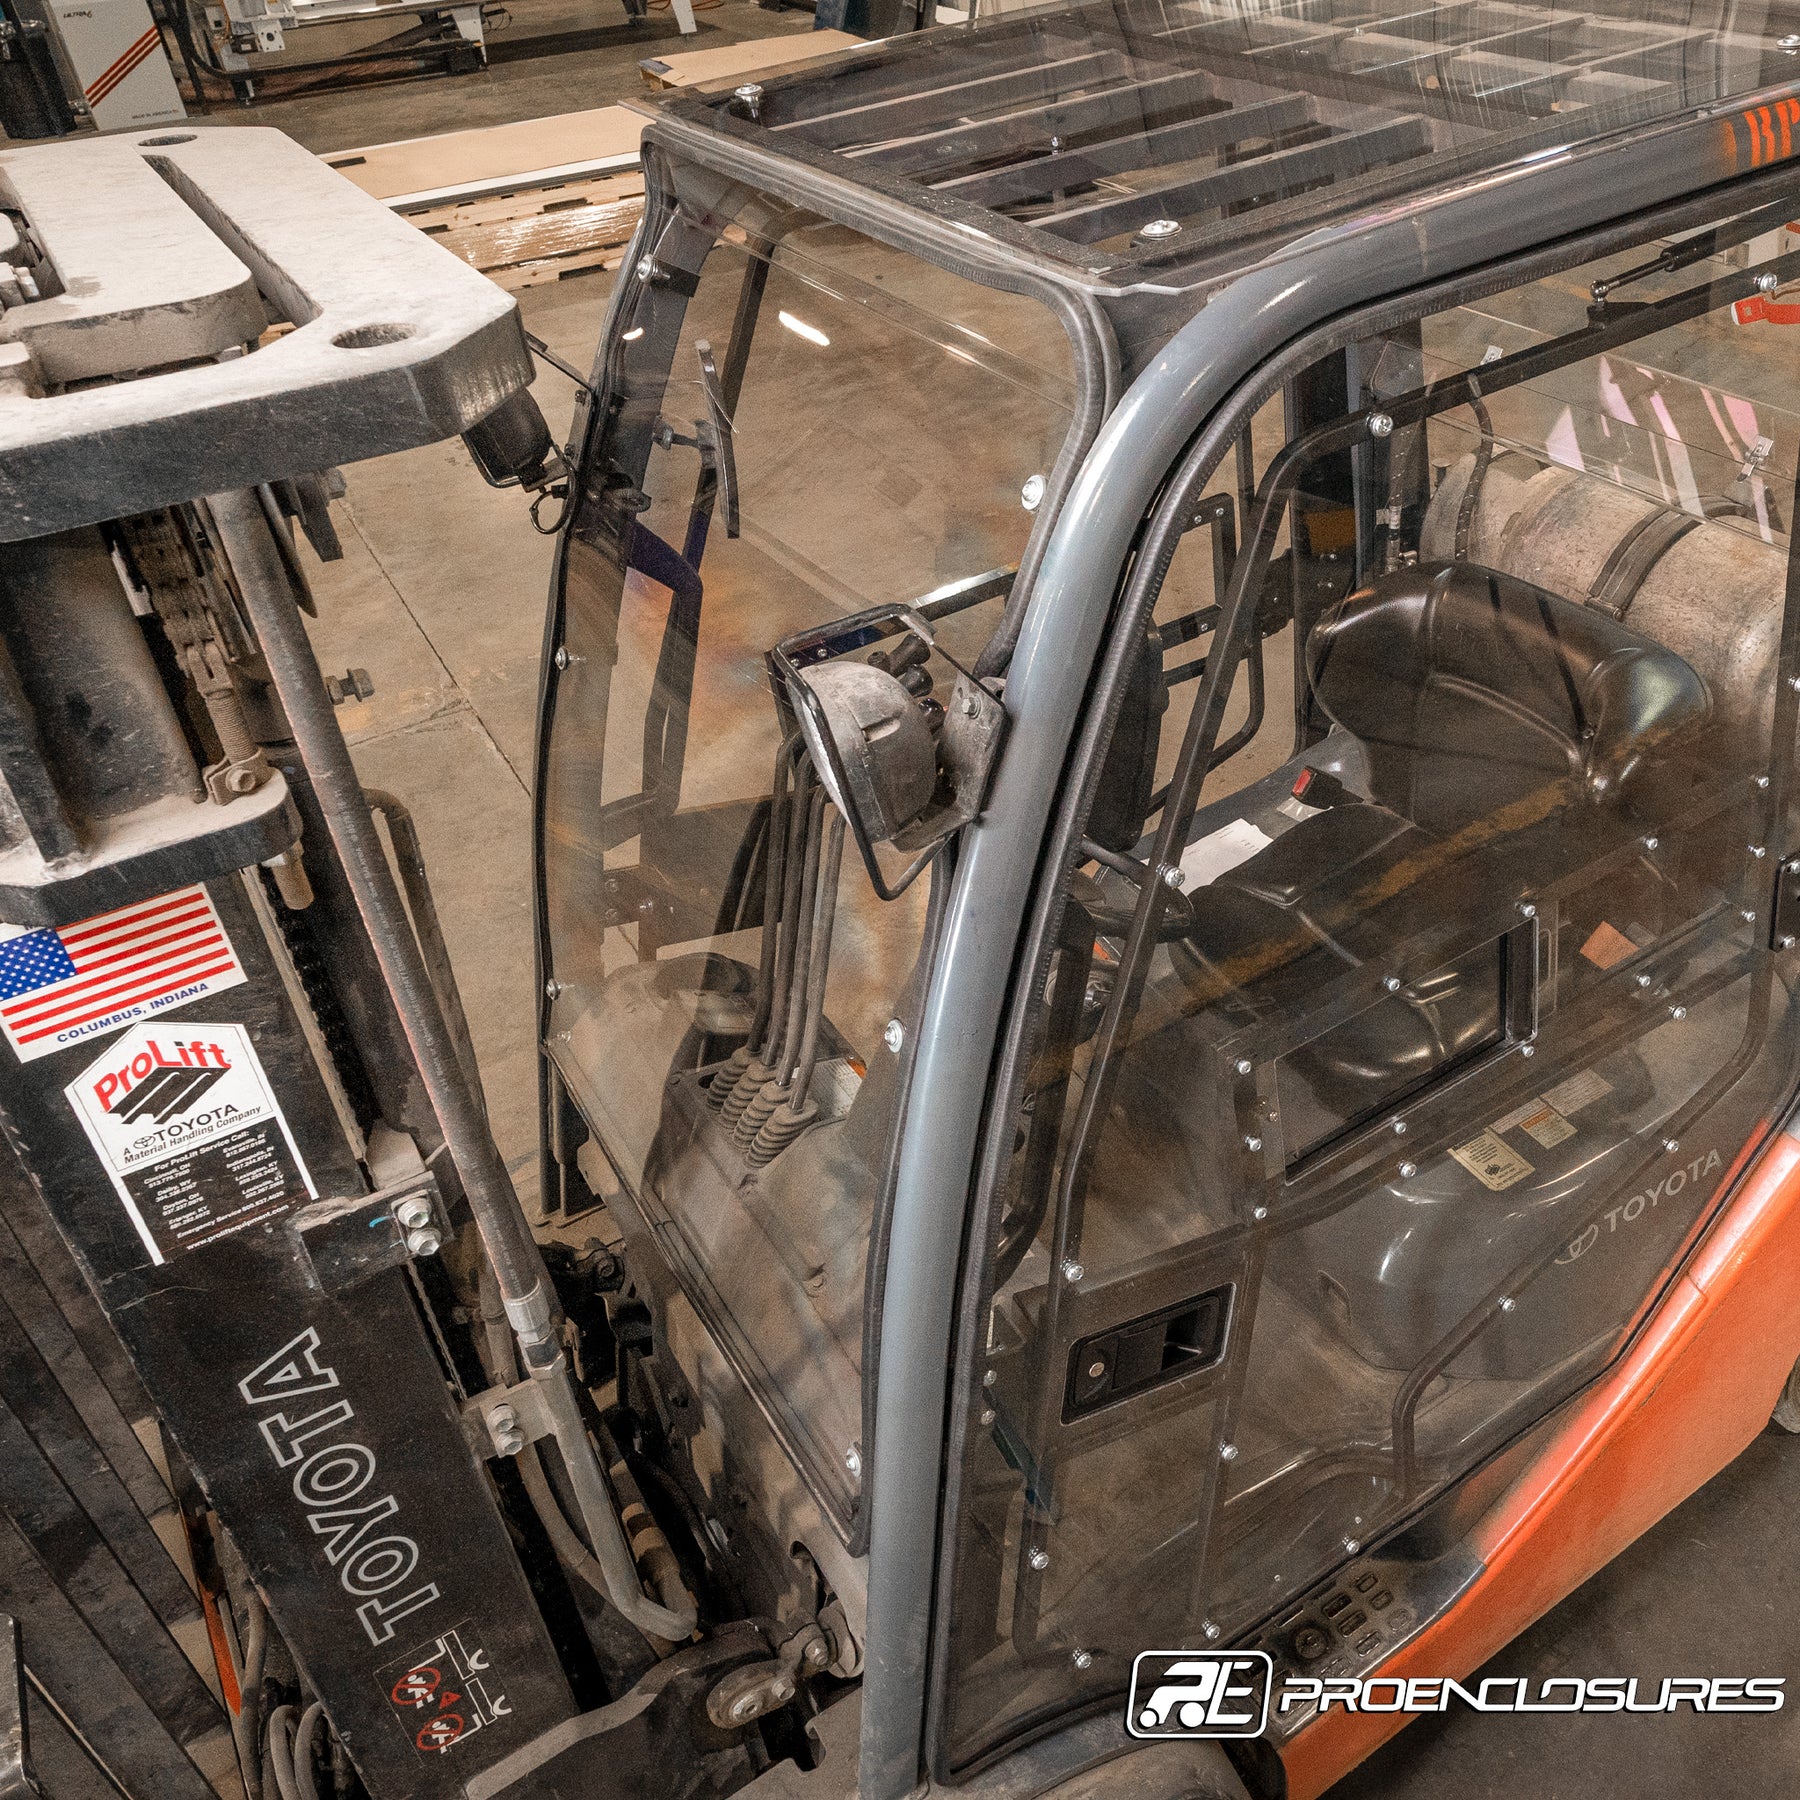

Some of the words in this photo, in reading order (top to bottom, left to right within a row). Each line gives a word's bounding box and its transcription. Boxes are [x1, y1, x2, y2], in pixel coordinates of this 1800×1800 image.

[56, 1006, 147, 1044] COLUMBUS,
[149, 982, 209, 1010] INDIANA
[93, 1040, 231, 1113] ProLift
[123, 1147, 130, 1156] A
[153, 1104, 238, 1142] TOYOTA
[124, 1142, 167, 1164] Material
[169, 1124, 214, 1146] Handling
[216, 1106, 262, 1128] Company
[153, 1161, 169, 1171] For
[169, 1149, 198, 1165] ProLift
[198, 1137, 230, 1154] Service
[230, 1129, 249, 1142] Call:
[1604, 1149, 1723, 1232] TOYOTA
[176, 1219, 216, 1239] Emergency
[216, 1208, 242, 1222] Service
[186, 1205, 289, 1250] www.proliftequipment.com
[238, 1326, 441, 1646] TOYOTA
